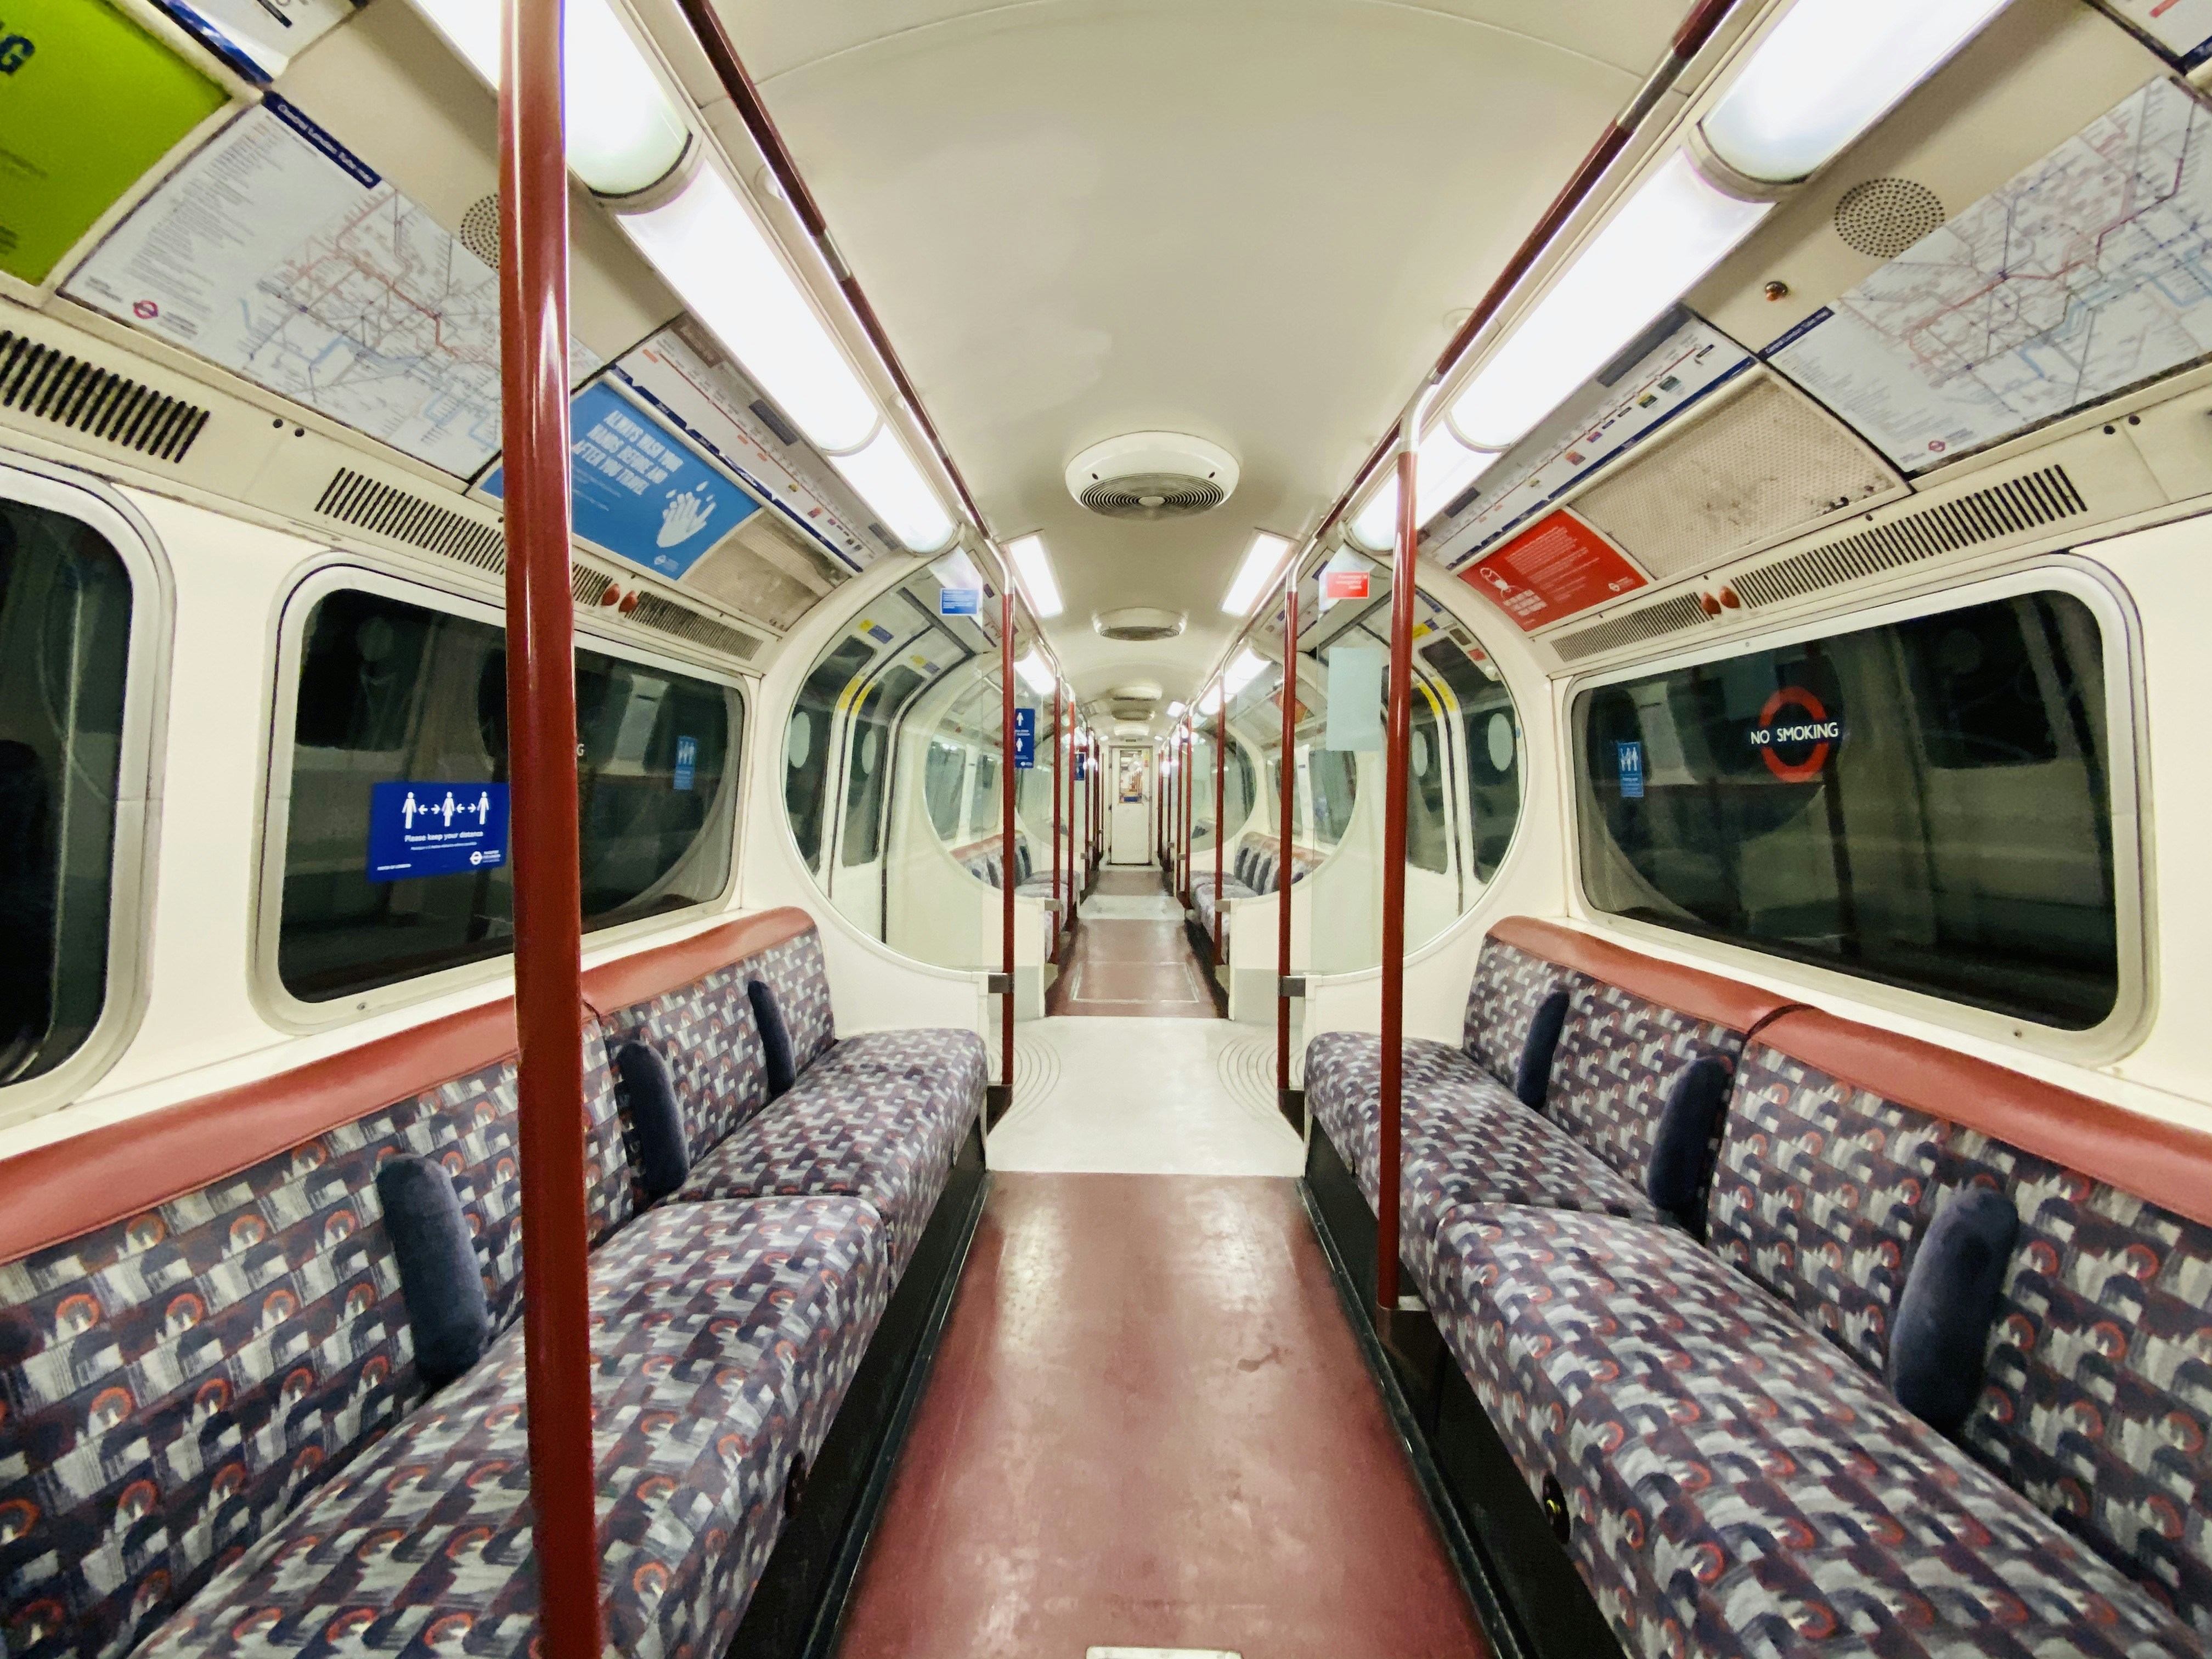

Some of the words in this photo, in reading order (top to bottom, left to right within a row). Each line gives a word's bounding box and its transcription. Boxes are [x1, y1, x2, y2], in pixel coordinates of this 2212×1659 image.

[571, 439, 606, 466] AFTER
[599, 457, 624, 477] YOU
[616, 469, 650, 495] TRAVEL
[586, 424, 624, 453] HANDS
[617, 445, 654, 474] BEFORE
[645, 466, 668, 484] AND
[603, 410, 644, 442] ALWAYS
[636, 433, 665, 459] WASH
[658, 449, 684, 473] YOUR
[1751, 730, 1770, 744] NO
[1777, 722, 1838, 742] SMOKING
